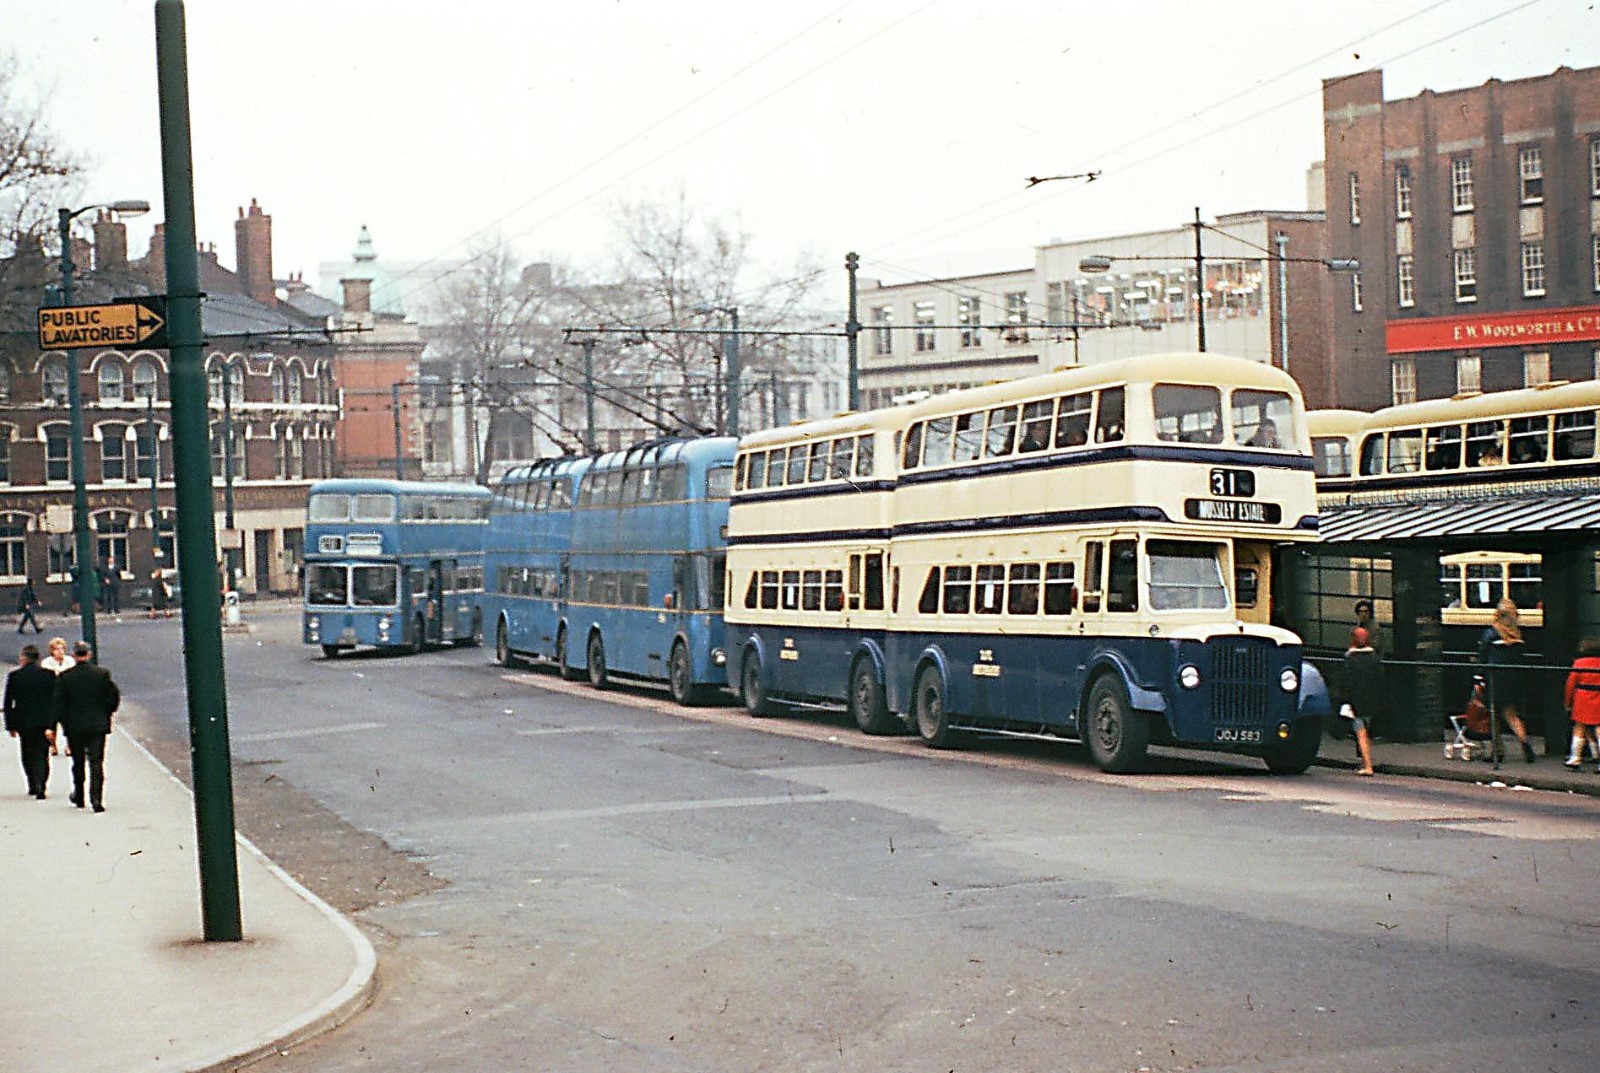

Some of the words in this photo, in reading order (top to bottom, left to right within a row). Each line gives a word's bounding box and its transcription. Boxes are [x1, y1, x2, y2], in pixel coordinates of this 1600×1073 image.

[41, 310, 101, 327] PUBLIC
[42, 324, 137, 345] LAVATORIES
[1482, 321, 1562, 337] WOOLWORTH
[1211, 473, 1235, 495] 31
